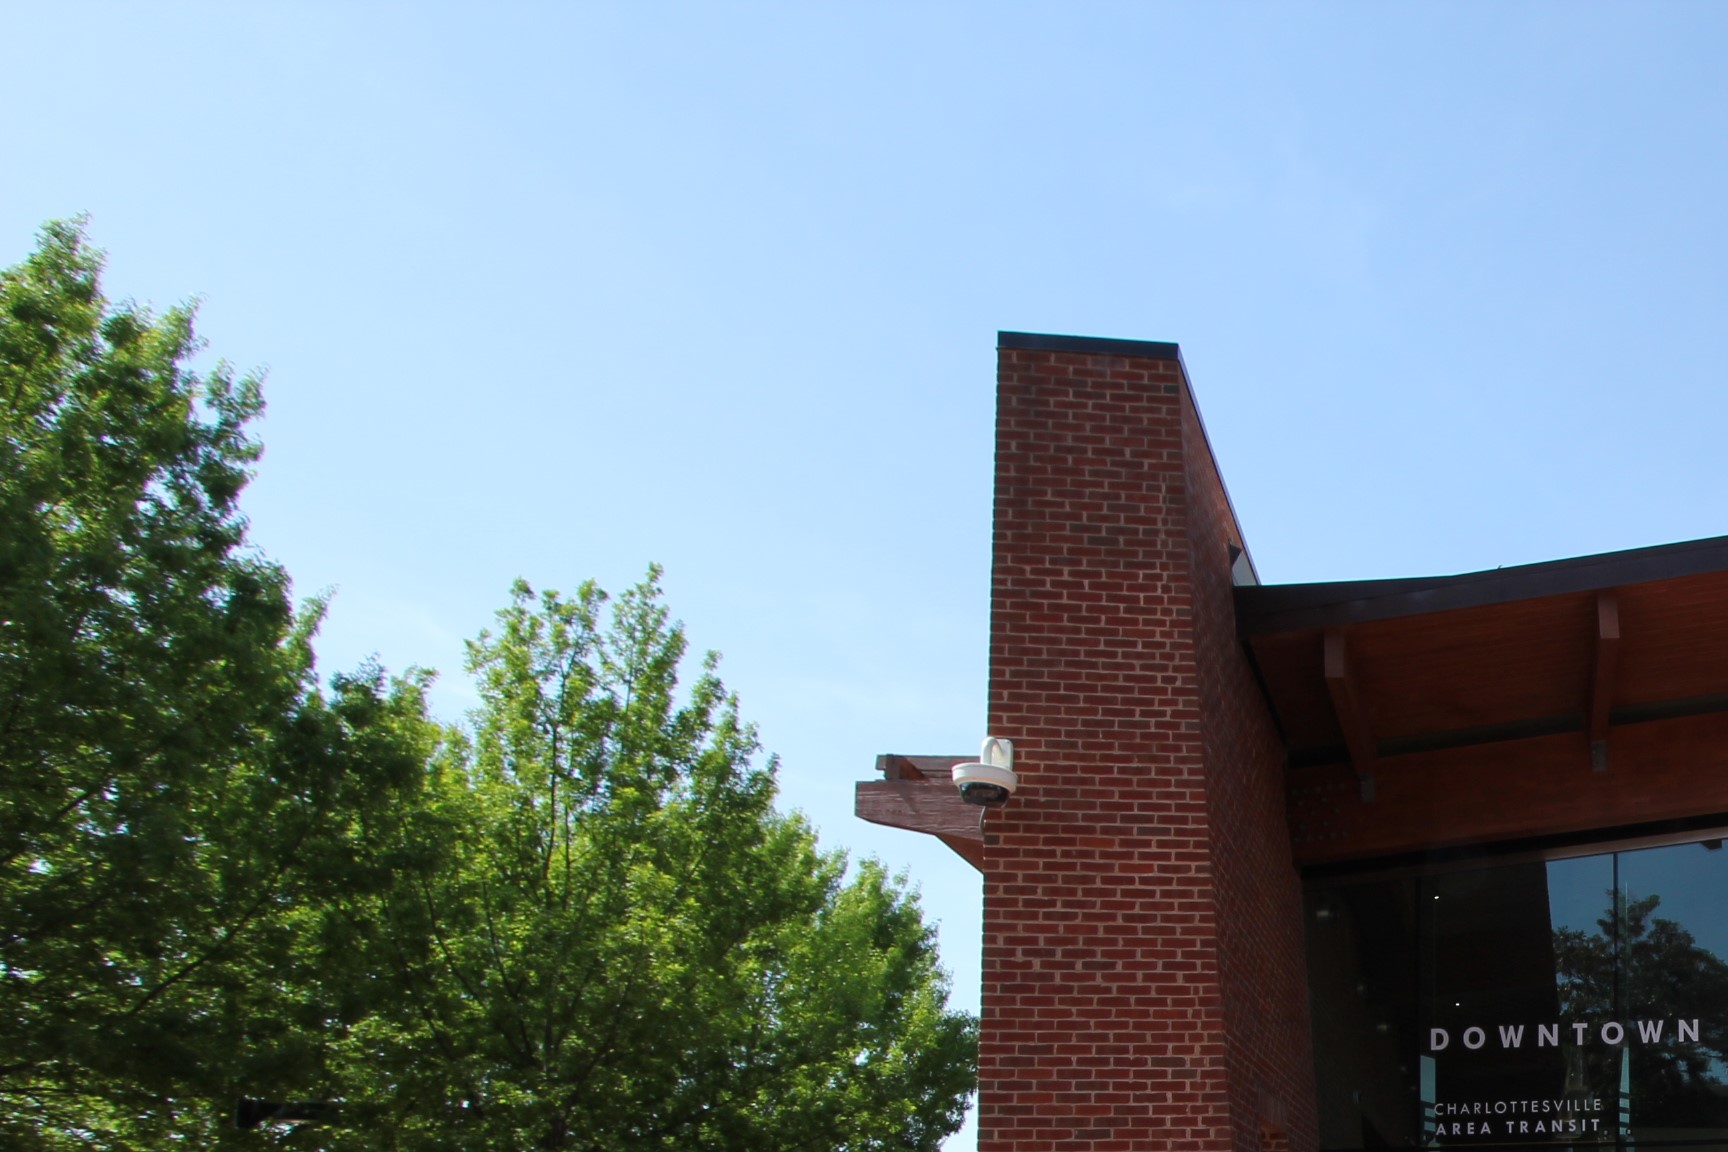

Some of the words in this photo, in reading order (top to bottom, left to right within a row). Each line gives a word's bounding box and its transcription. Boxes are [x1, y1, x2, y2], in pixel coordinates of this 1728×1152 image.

[1430, 1018, 1699, 1050] DOWNTOWN
[1434, 1098, 1601, 1116] CHARLOTTESVILLE
[1436, 1121, 1491, 1136] AREA
[1506, 1118, 1600, 1134] TRANSIT
